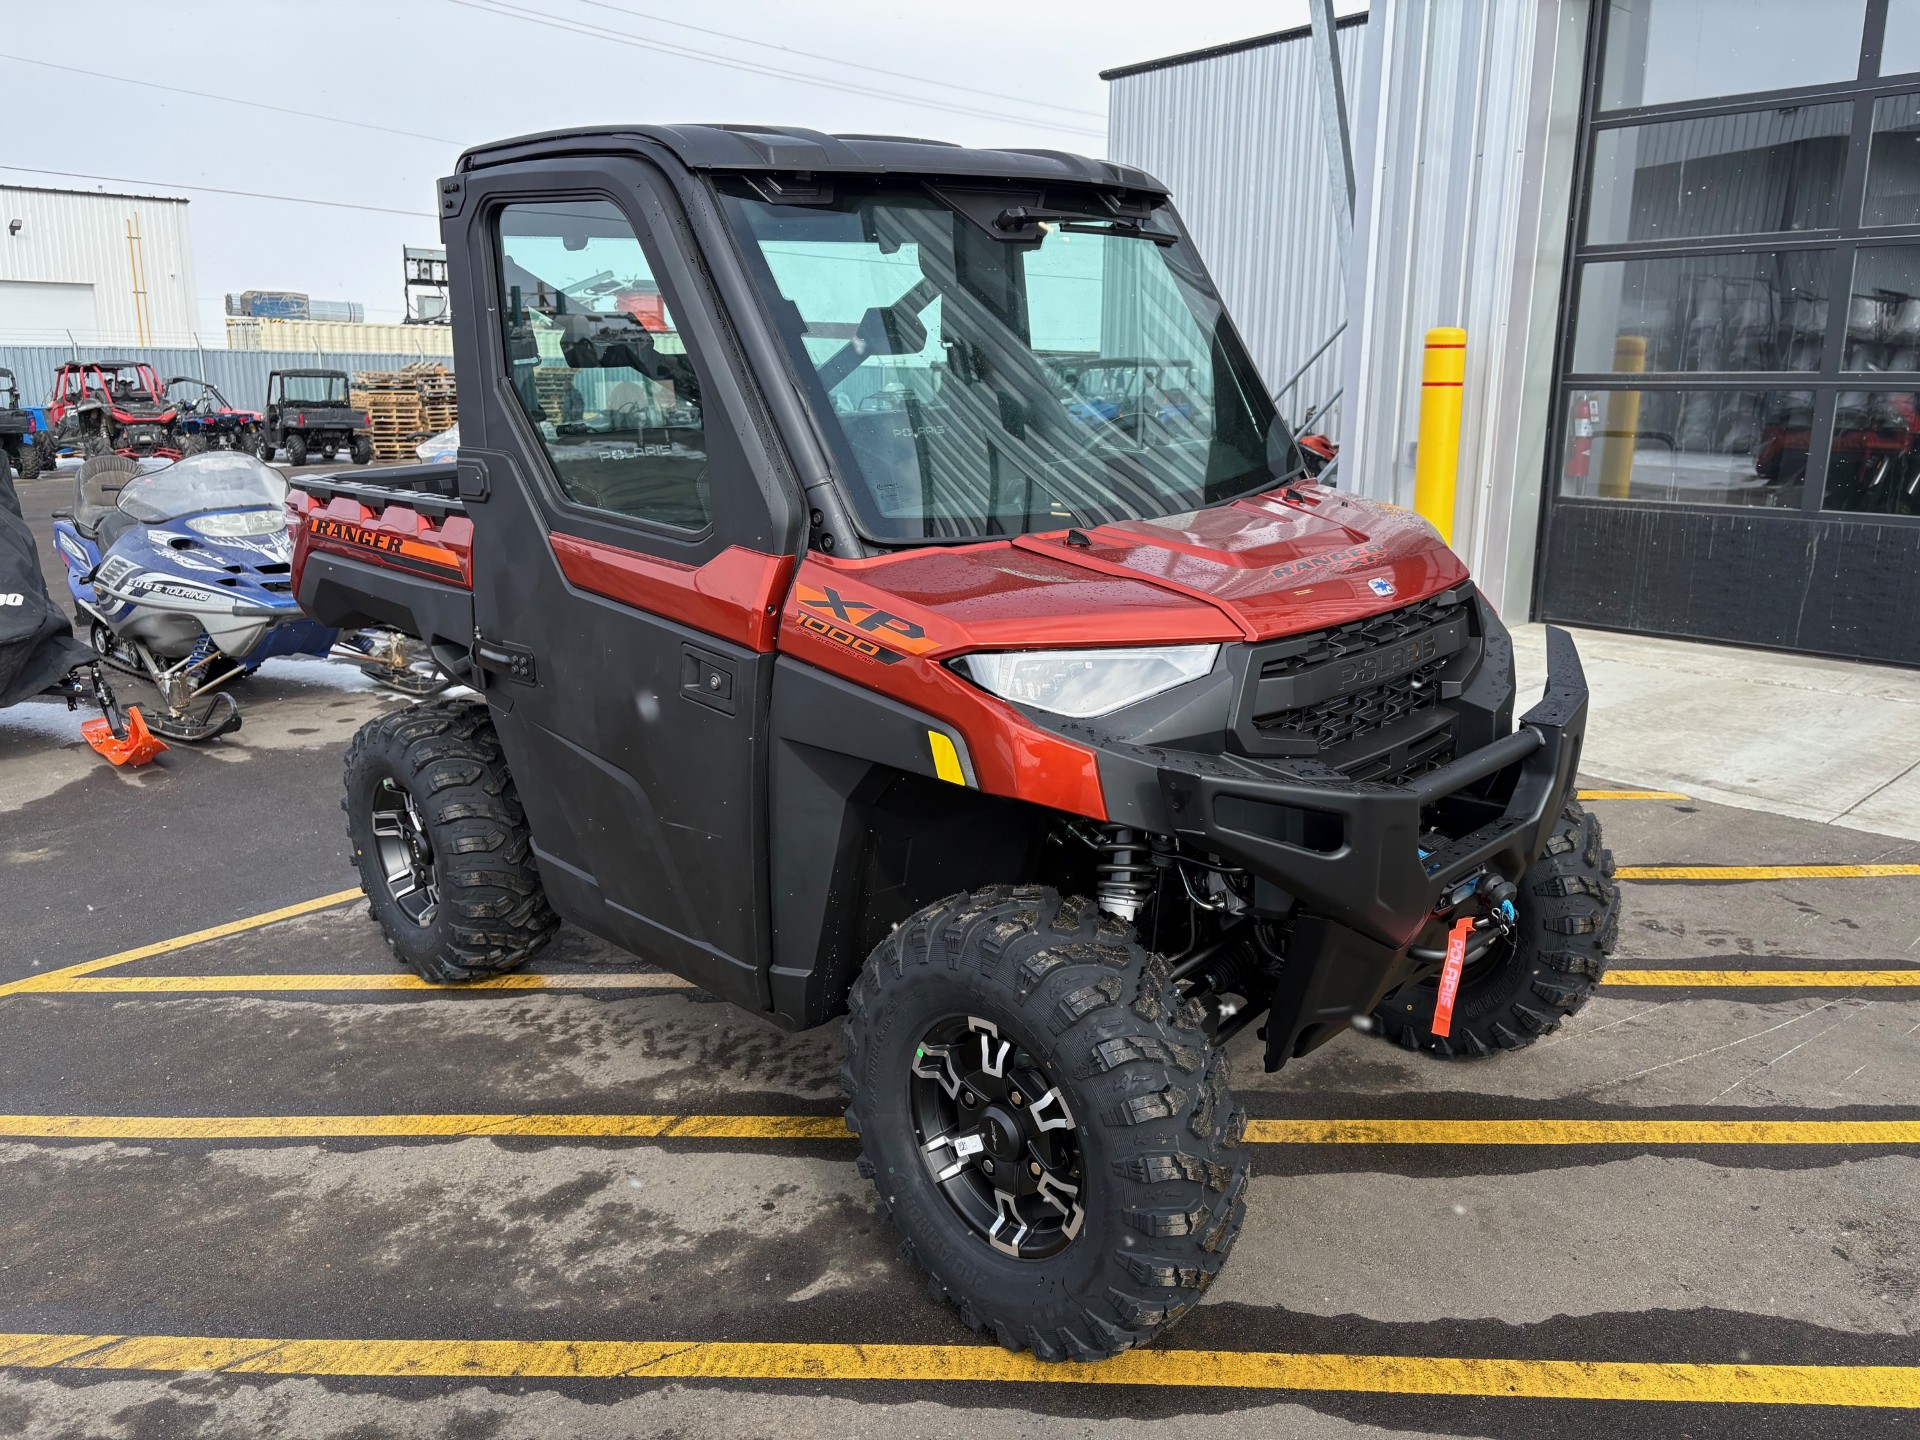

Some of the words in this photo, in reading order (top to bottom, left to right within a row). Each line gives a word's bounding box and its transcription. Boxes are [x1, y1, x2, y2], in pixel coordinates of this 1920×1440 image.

[599, 444, 671, 462] POLARIS
[317, 519, 404, 553] RANGER
[1270, 544, 1386, 579] RANGER
[1342, 552, 1387, 572] XP
[126, 578, 164, 593] EDGE
[164, 586, 211, 601] TOURING
[800, 585, 926, 639] XP
[796, 613, 880, 656] 1000
[1339, 634, 1435, 690] POLARIS
[1440, 938, 1463, 1008] POLARIS
